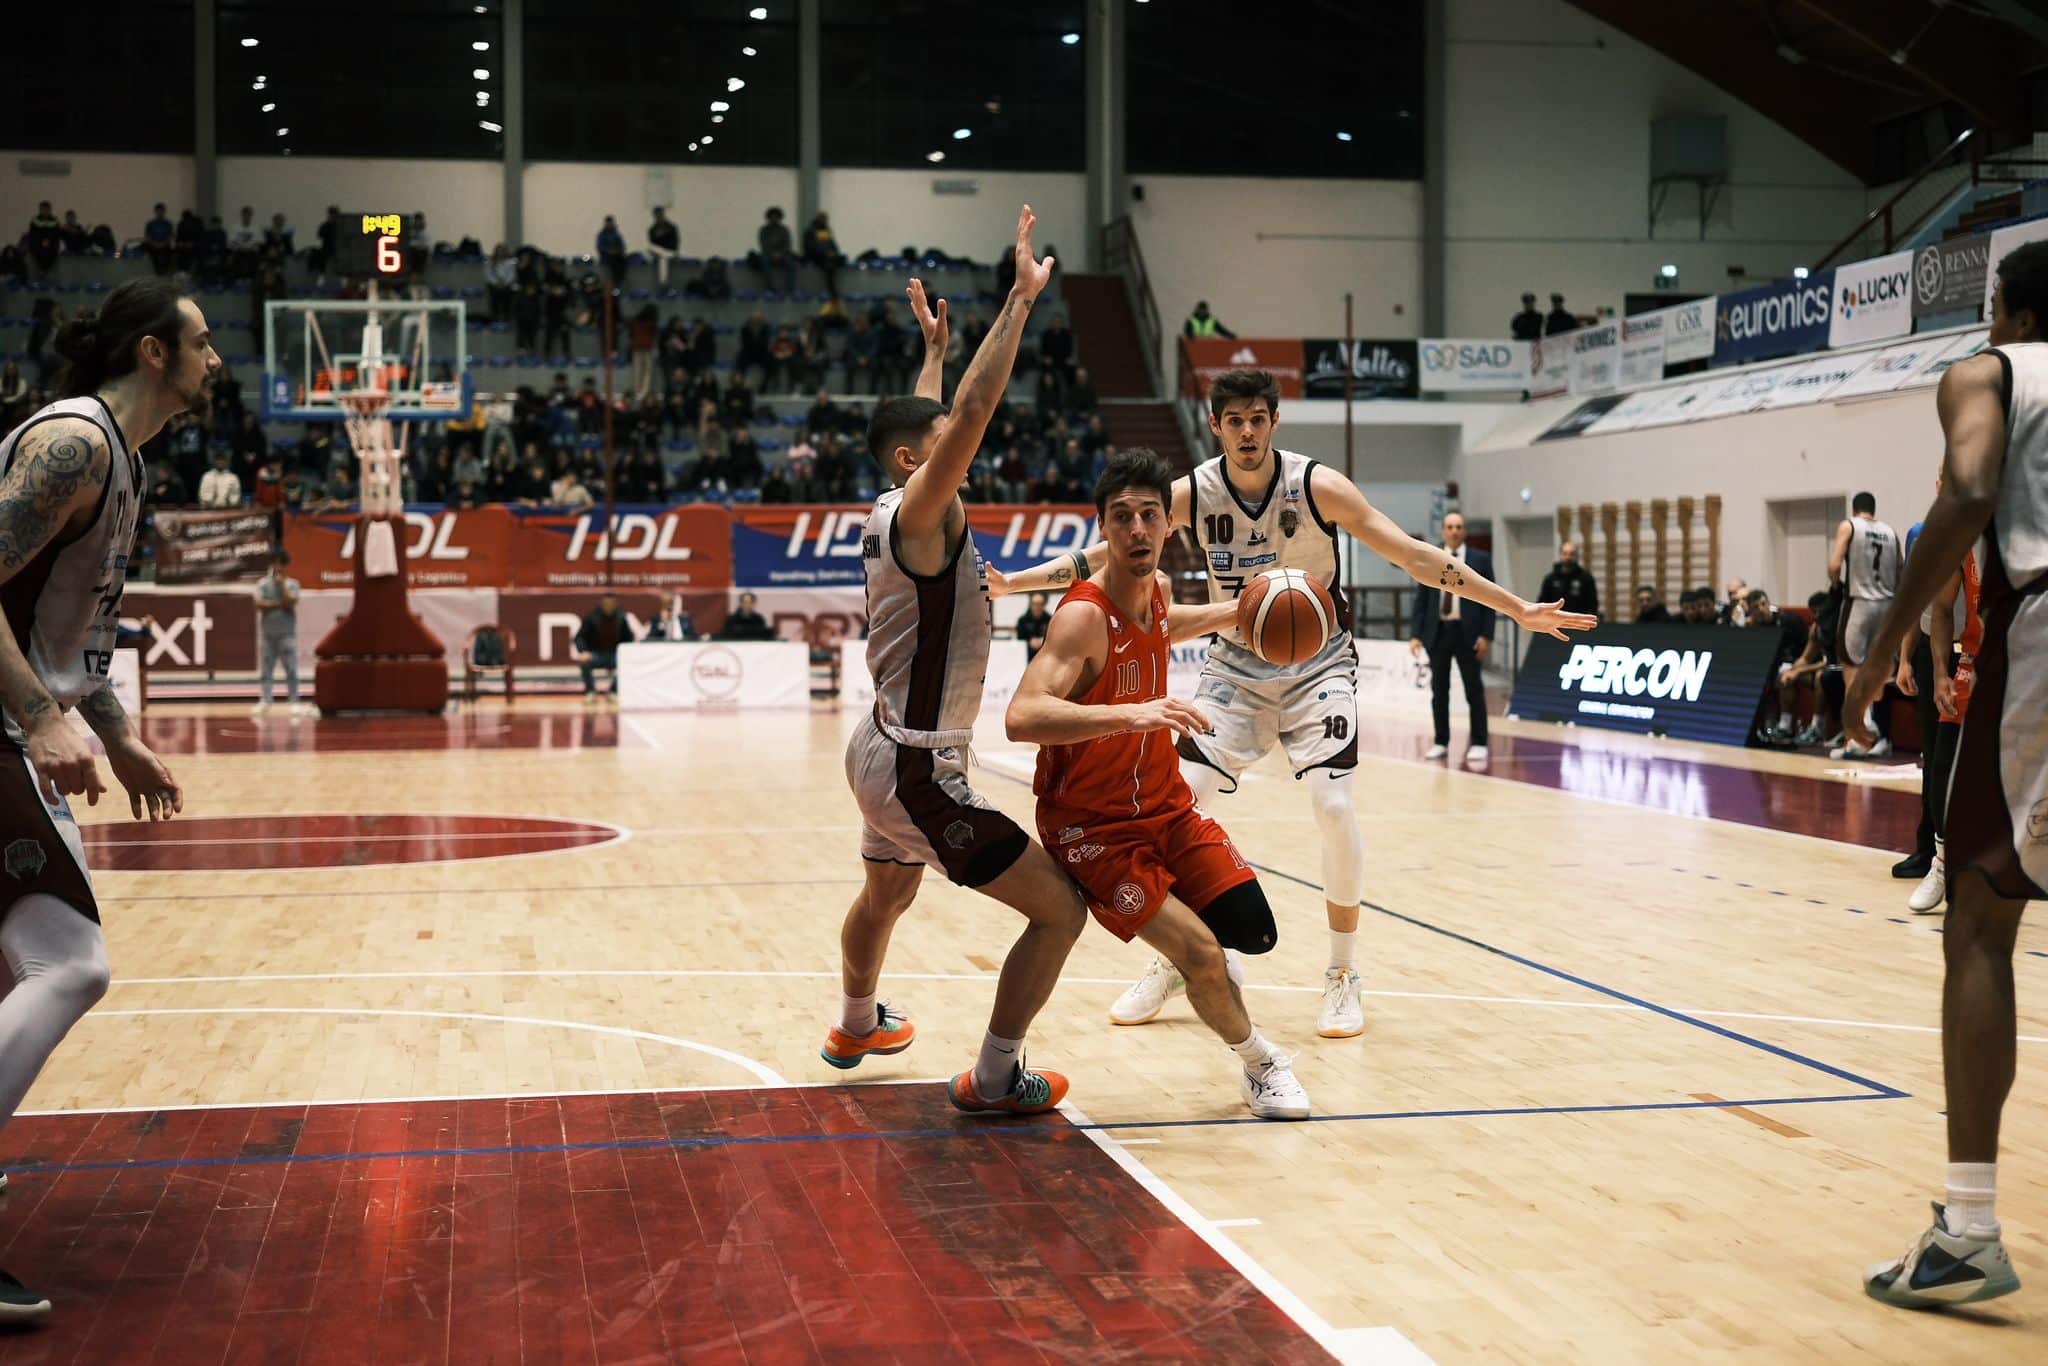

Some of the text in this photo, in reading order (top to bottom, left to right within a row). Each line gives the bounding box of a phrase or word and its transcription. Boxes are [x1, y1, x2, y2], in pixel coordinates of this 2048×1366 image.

[362, 214, 401, 236] 1:49
[378, 236, 401, 272] 6
[1859, 272, 1909, 304] LUCKY
[1730, 281, 1829, 340] euronics
[1459, 345, 1512, 368] SAD
[566, 514, 692, 561] HDL
[786, 512, 865, 559] HD
[1204, 514, 1234, 545] 10
[1115, 659, 1140, 698] 10
[1559, 644, 1713, 702] PERCON
[1321, 715, 1348, 740] 10
